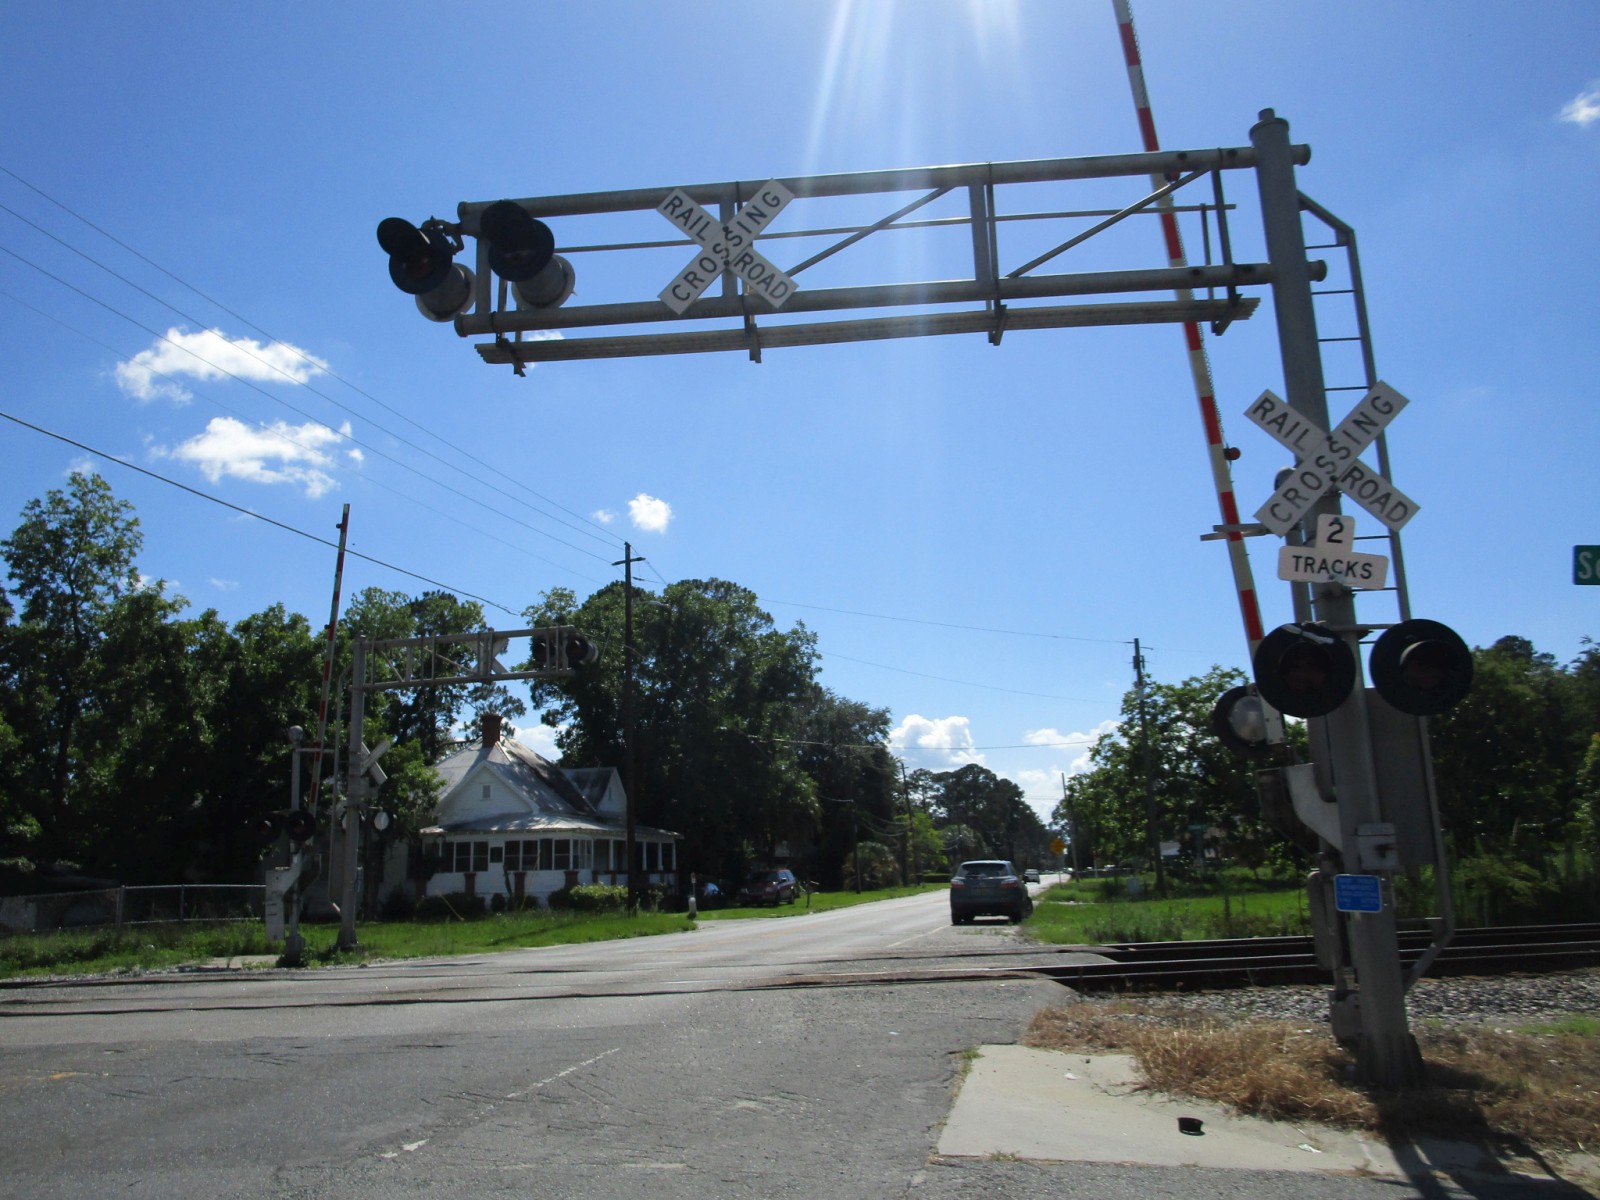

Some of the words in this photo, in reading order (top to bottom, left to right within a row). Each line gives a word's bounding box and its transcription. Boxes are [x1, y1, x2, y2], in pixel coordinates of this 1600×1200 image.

[663, 195, 711, 242] RAIL
[734, 252, 788, 299] ROAD
[671, 191, 781, 302] CROSSING
[1252, 397, 1310, 453] RAIL
[1341, 465, 1409, 523] ROAD
[1269, 395, 1394, 523] CROSSING
[1292, 555, 1373, 580] TRACKS
[1327, 521, 1345, 544] 2
